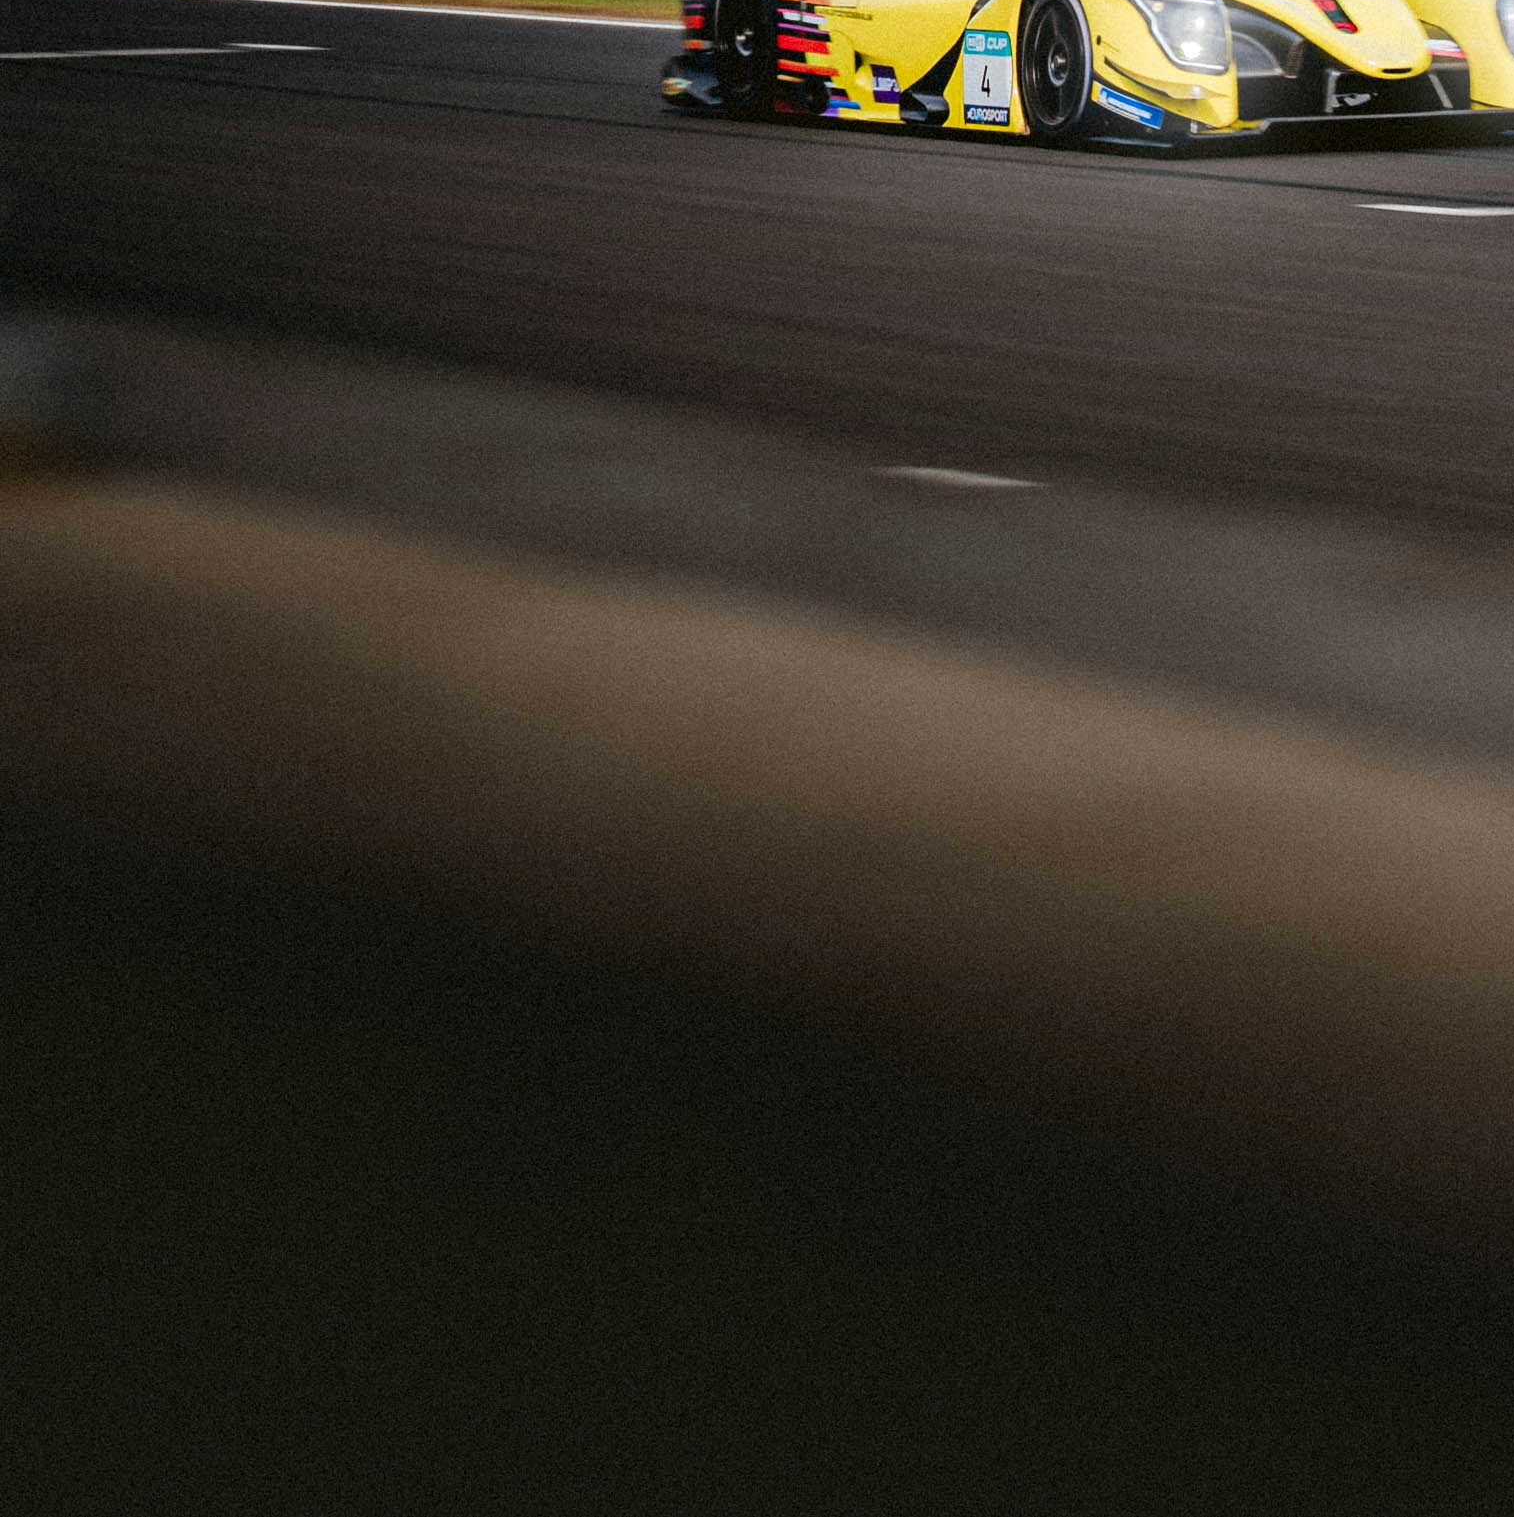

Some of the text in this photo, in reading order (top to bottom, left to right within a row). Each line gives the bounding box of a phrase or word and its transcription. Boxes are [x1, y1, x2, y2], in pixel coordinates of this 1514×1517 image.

[987, 37, 1008, 51] CUP
[981, 65, 991, 98] 4
[970, 107, 1008, 123] EUROSPORT
